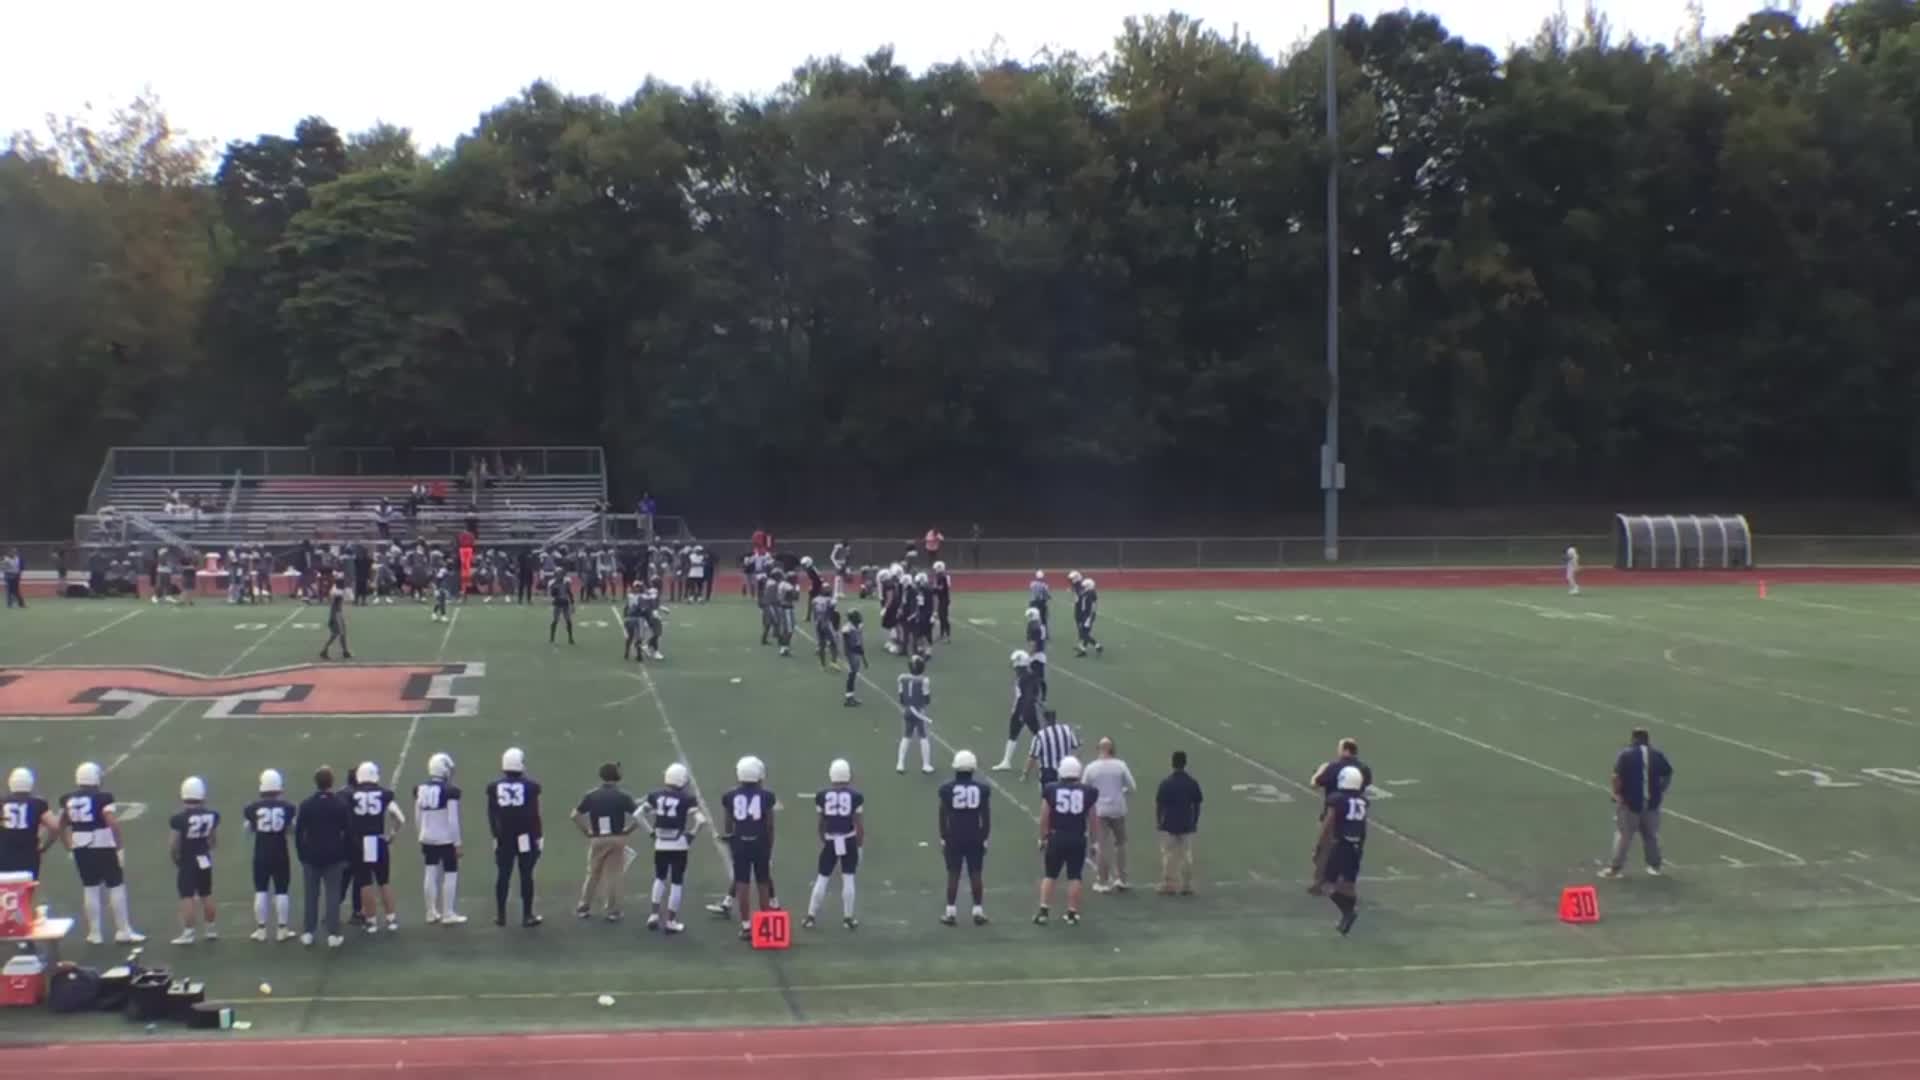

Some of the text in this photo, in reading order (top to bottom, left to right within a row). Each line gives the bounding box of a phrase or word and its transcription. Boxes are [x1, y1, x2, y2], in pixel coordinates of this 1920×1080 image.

[353, 790, 382, 816] 35
[497, 783, 525, 807] 53
[655, 795, 680, 817] 17
[733, 794, 763, 821] 84
[824, 790, 853, 816] 29
[952, 785, 981, 809] 20
[1055, 787, 1085, 814] 58
[2, 802, 29, 830] 51
[256, 807, 284, 833] 26
[1345, 797, 1368, 821] 13
[187, 815, 215, 840] 27
[1571, 891, 1596, 917] 30
[757, 914, 786, 942] 40
